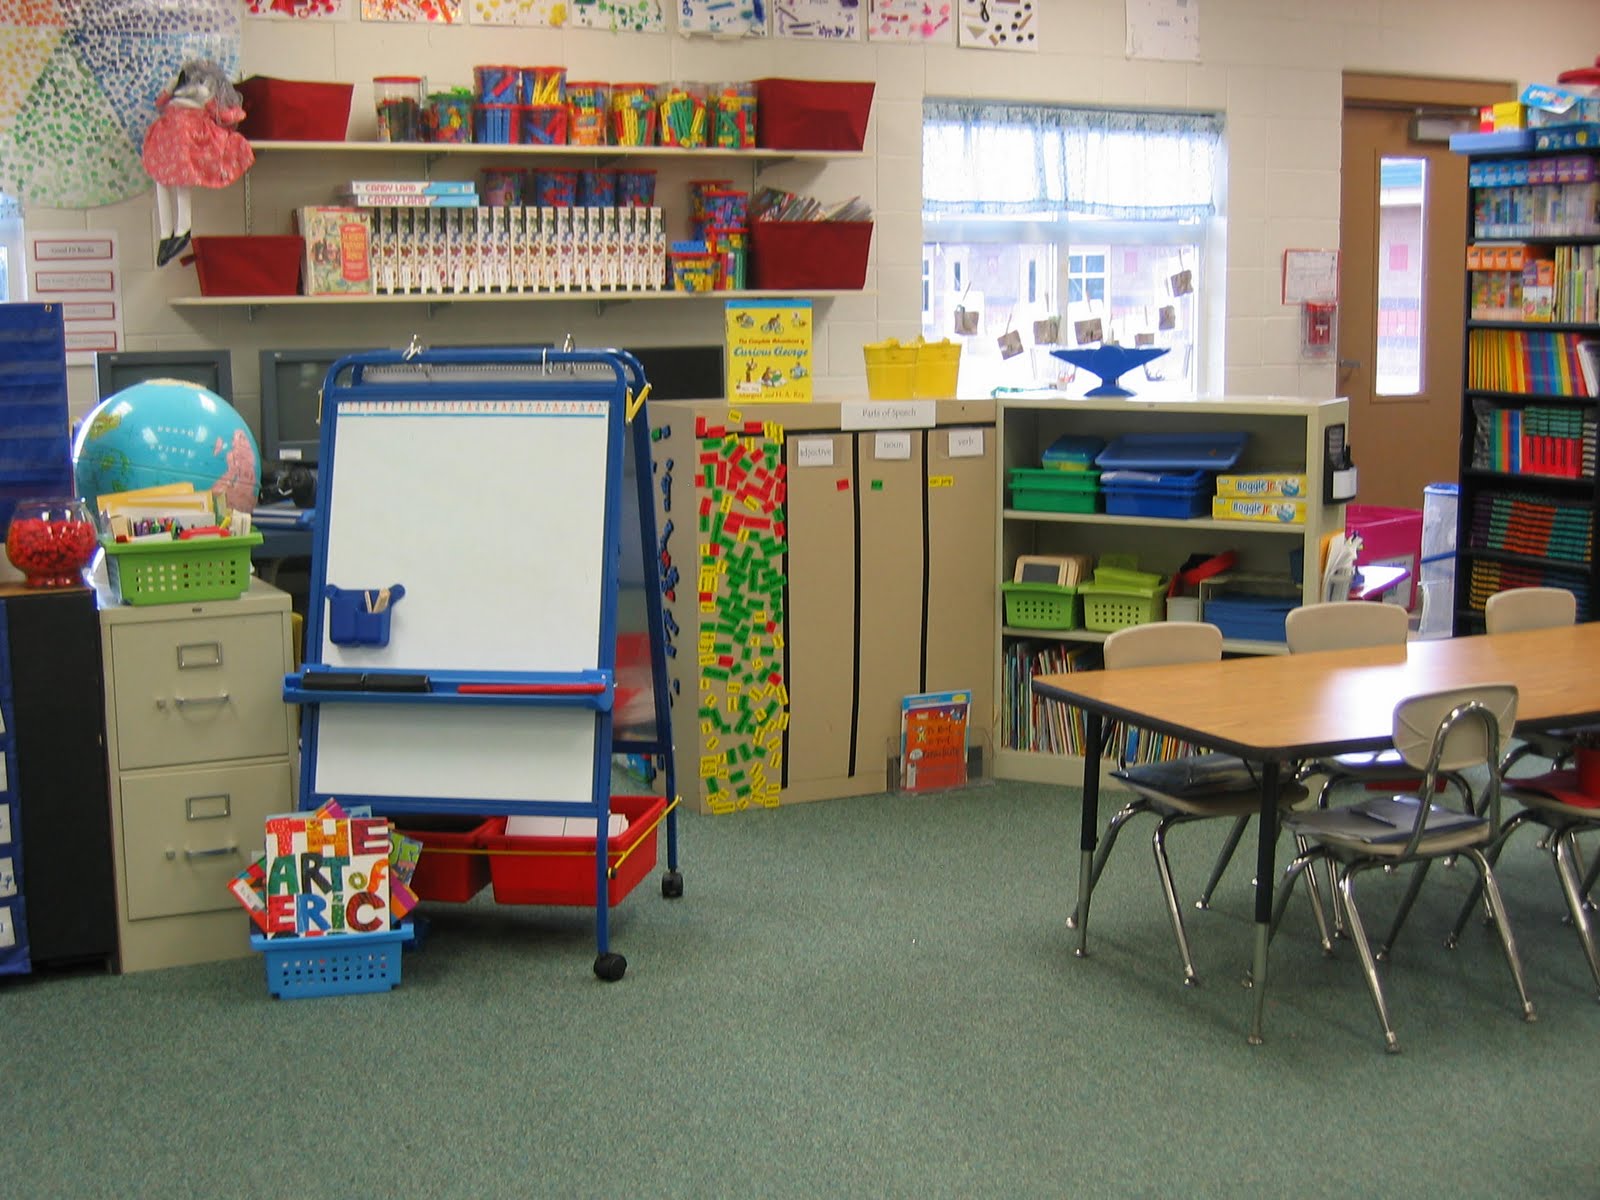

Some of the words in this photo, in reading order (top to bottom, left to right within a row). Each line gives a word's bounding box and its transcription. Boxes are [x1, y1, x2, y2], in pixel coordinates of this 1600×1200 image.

[365, 183, 393, 193] CANDY
[395, 183, 417, 193] LAND
[734, 347, 771, 357] Curious
[774, 347, 808, 359] George
[862, 408, 881, 418] Parts
[881, 408, 891, 418] of
[883, 440, 904, 449] noun
[957, 437, 974, 448] verb
[800, 447, 832, 460] adjective
[1236, 480, 1266, 494] Boggle
[1232, 502, 1261, 515] Boggle
[266, 818, 390, 857] THE
[268, 853, 349, 895] ART
[268, 892, 386, 933] ERIC
